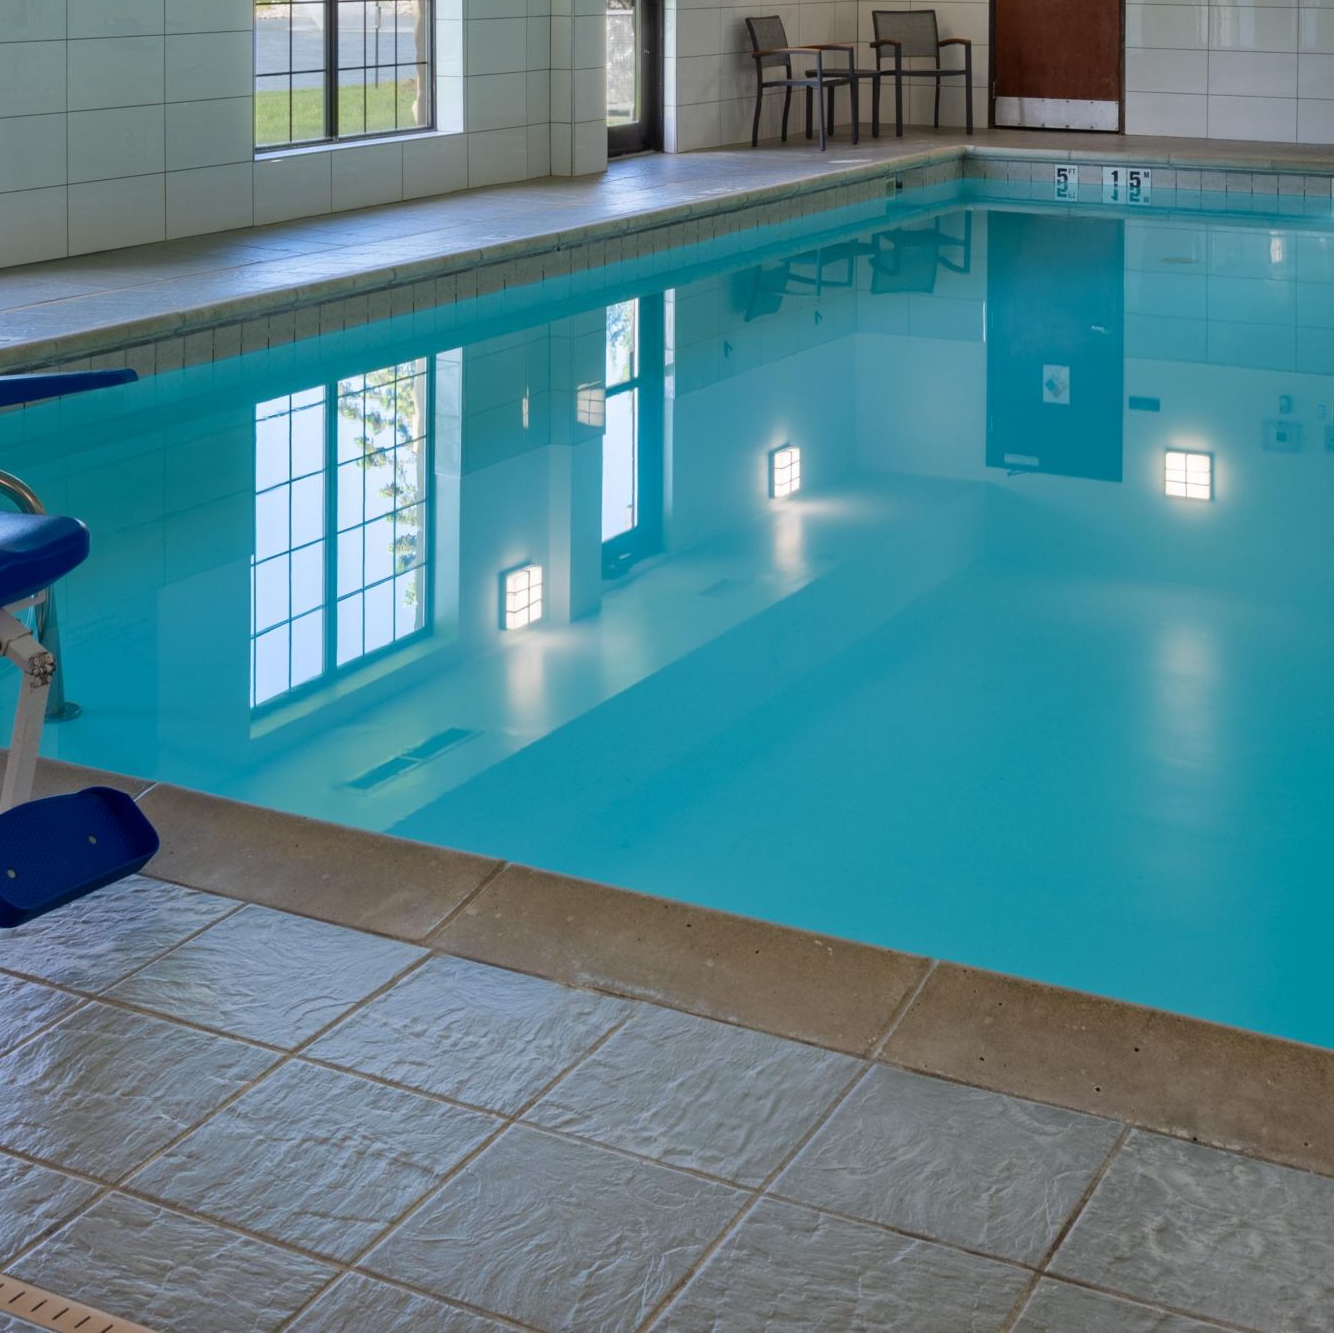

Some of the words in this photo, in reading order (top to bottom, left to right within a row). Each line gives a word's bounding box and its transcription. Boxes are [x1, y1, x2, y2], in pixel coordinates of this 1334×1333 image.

[1056, 168, 1068, 184] 5
[1111, 170, 1119, 186] 1
[1129, 171, 1141, 187] 5
[1143, 171, 1150, 179] M
